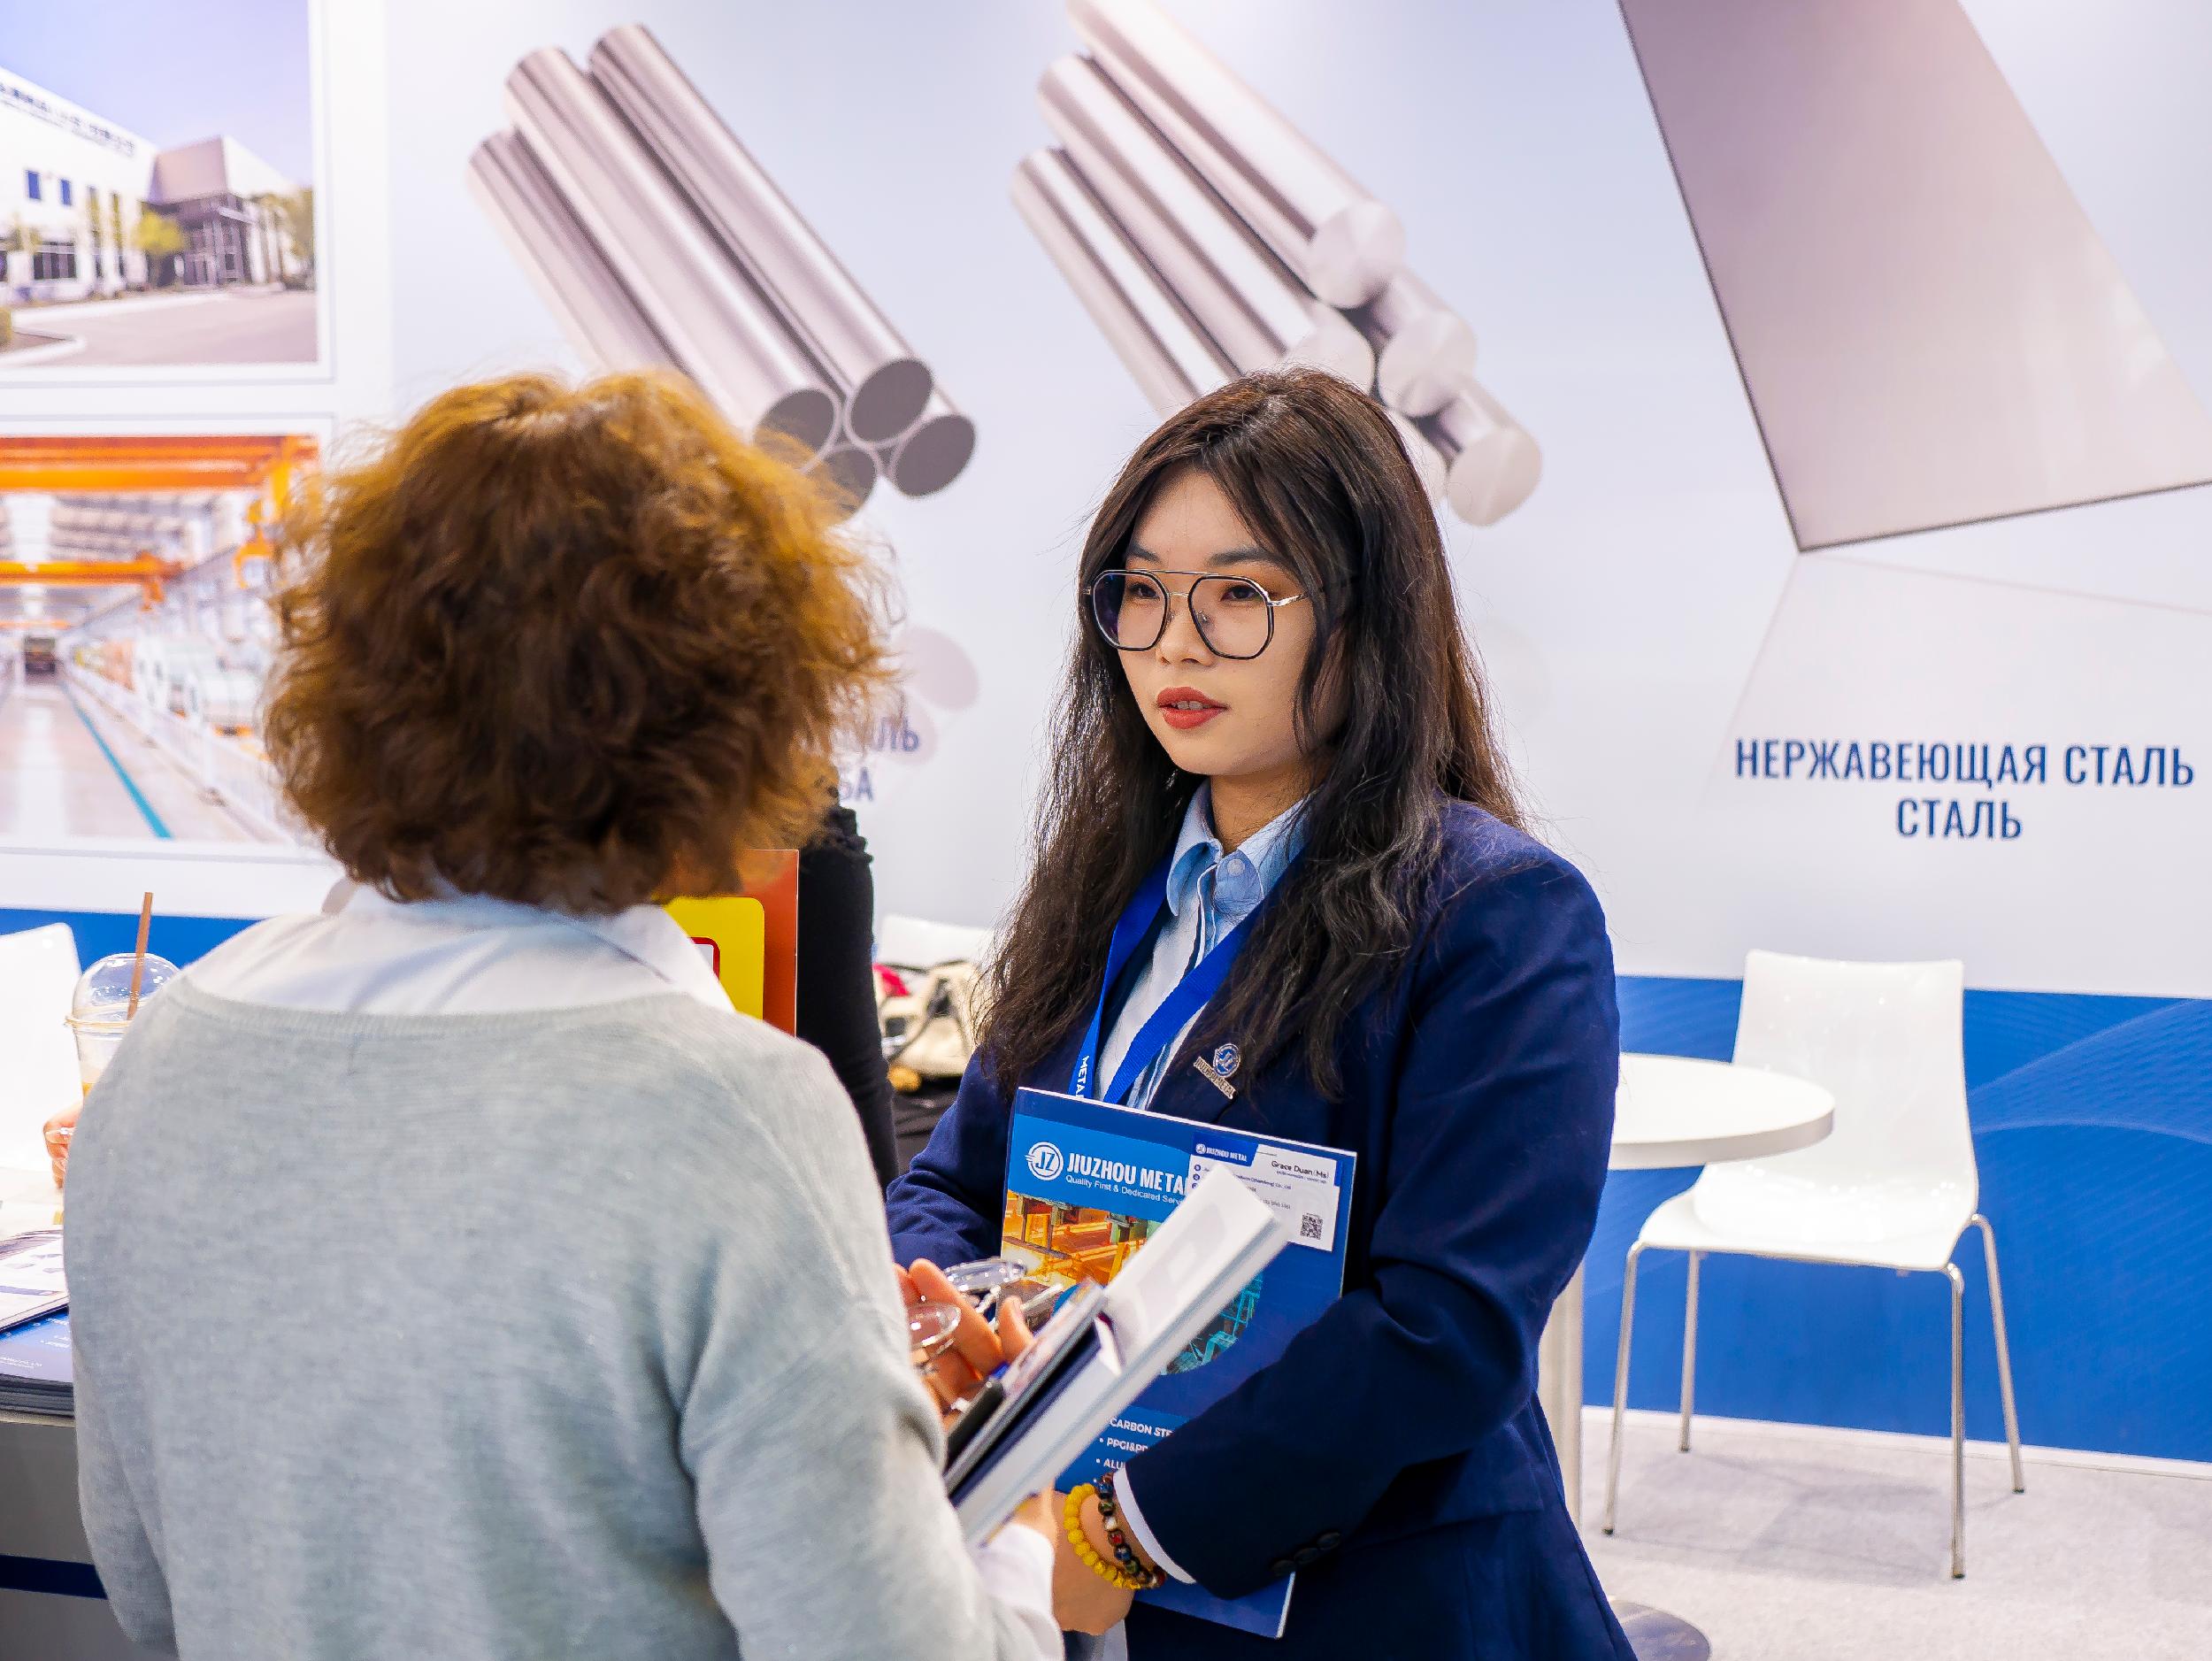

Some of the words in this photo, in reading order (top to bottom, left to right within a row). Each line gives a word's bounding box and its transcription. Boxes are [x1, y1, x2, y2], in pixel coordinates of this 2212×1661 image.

[872, 715, 919, 753] ЛЬ
[1735, 737, 2047, 789] НЕРЖАВЕЮЩАЯ
[2063, 744, 2195, 788] СТАЛЬ
[1896, 797, 2024, 840] СТАЛЬ
[1066, 1152, 1138, 1186] JIUZHOU
[1271, 1160, 1292, 1171] Grace
[1294, 1165, 1313, 1175] Duan
[1065, 1174, 1093, 1188] Quality
[1094, 1181, 1112, 1192] First
[1121, 1186, 1161, 1202] Dedicated
[1110, 1417, 1152, 1434] CARBON
[1103, 1458, 1125, 1470] ALU
